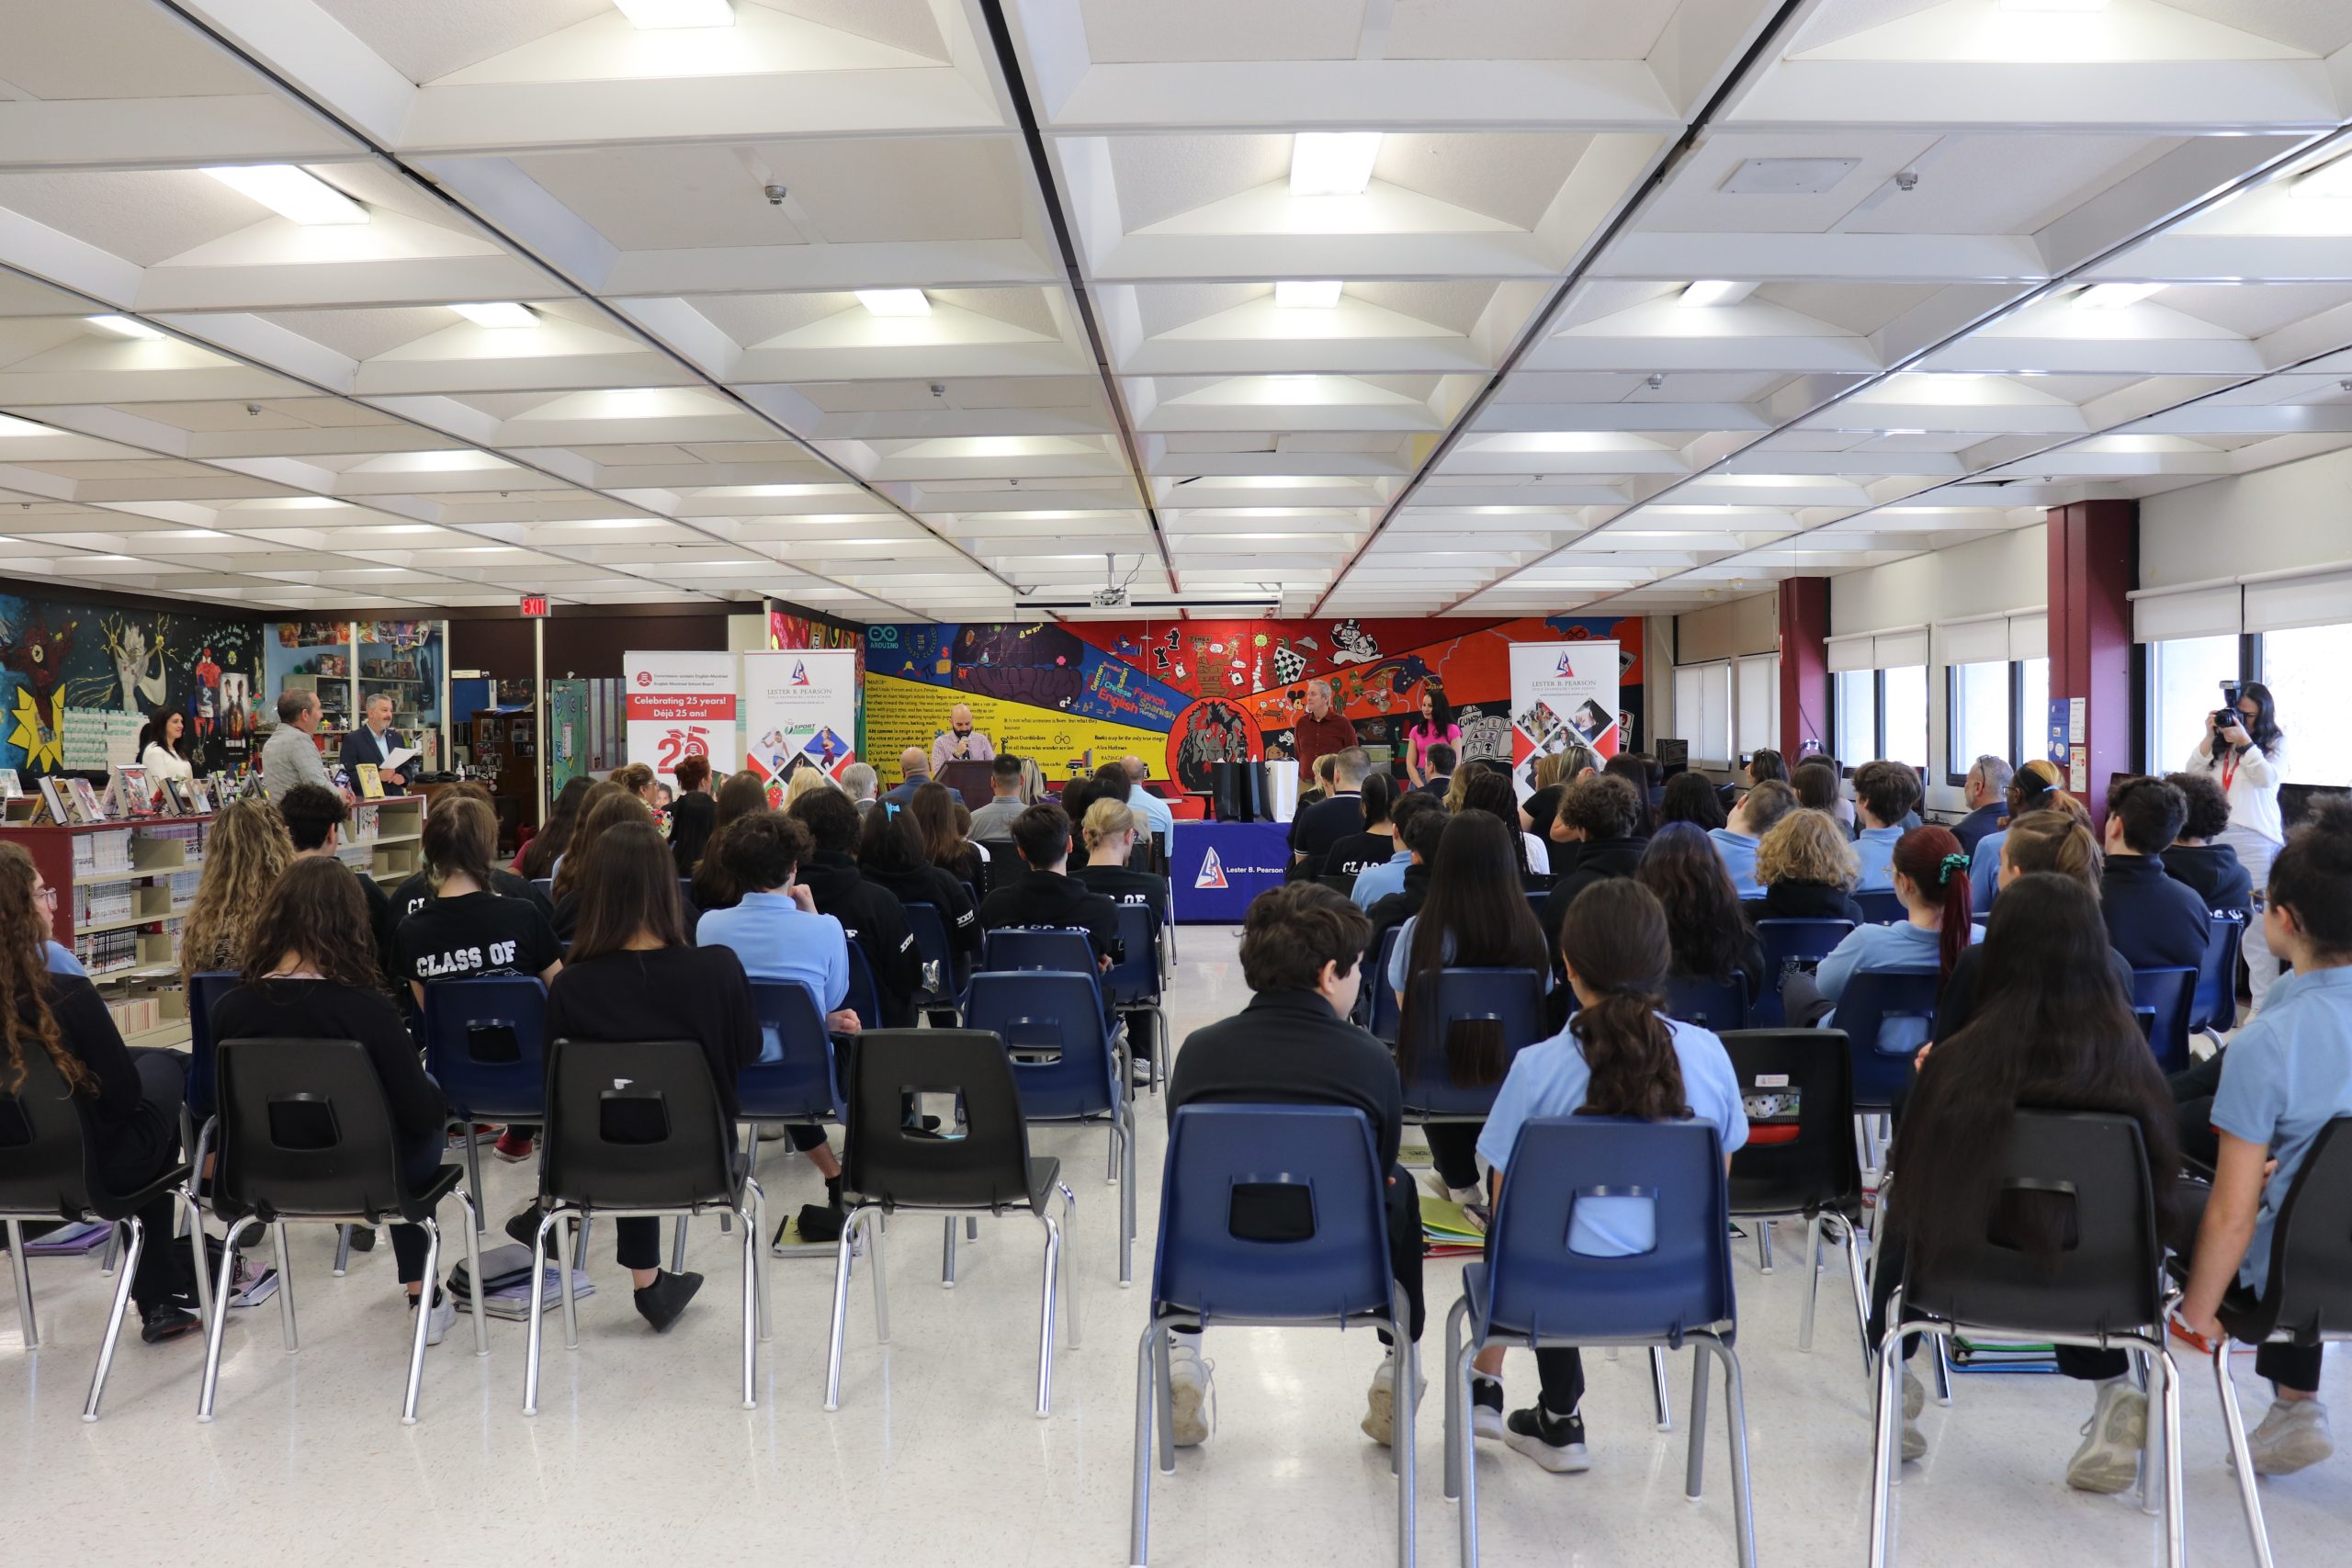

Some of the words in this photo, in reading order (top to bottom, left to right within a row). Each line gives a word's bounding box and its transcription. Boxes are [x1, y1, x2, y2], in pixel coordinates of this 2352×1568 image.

[523, 598, 546, 615] EXIT
[1091, 664, 1104, 692] German
[1104, 681, 1132, 698] Chinese
[1132, 686, 1168, 706] French
[634, 696, 684, 706] Celebrating
[686, 696, 698, 705] 25
[700, 696, 727, 706] years!
[1097, 686, 1139, 715] English
[1139, 698, 1177, 721] Spanish
[653, 708, 673, 719] Déjà
[689, 709, 707, 717] ans!
[416, 946, 483, 977] CLASS
[489, 940, 516, 965] OF
